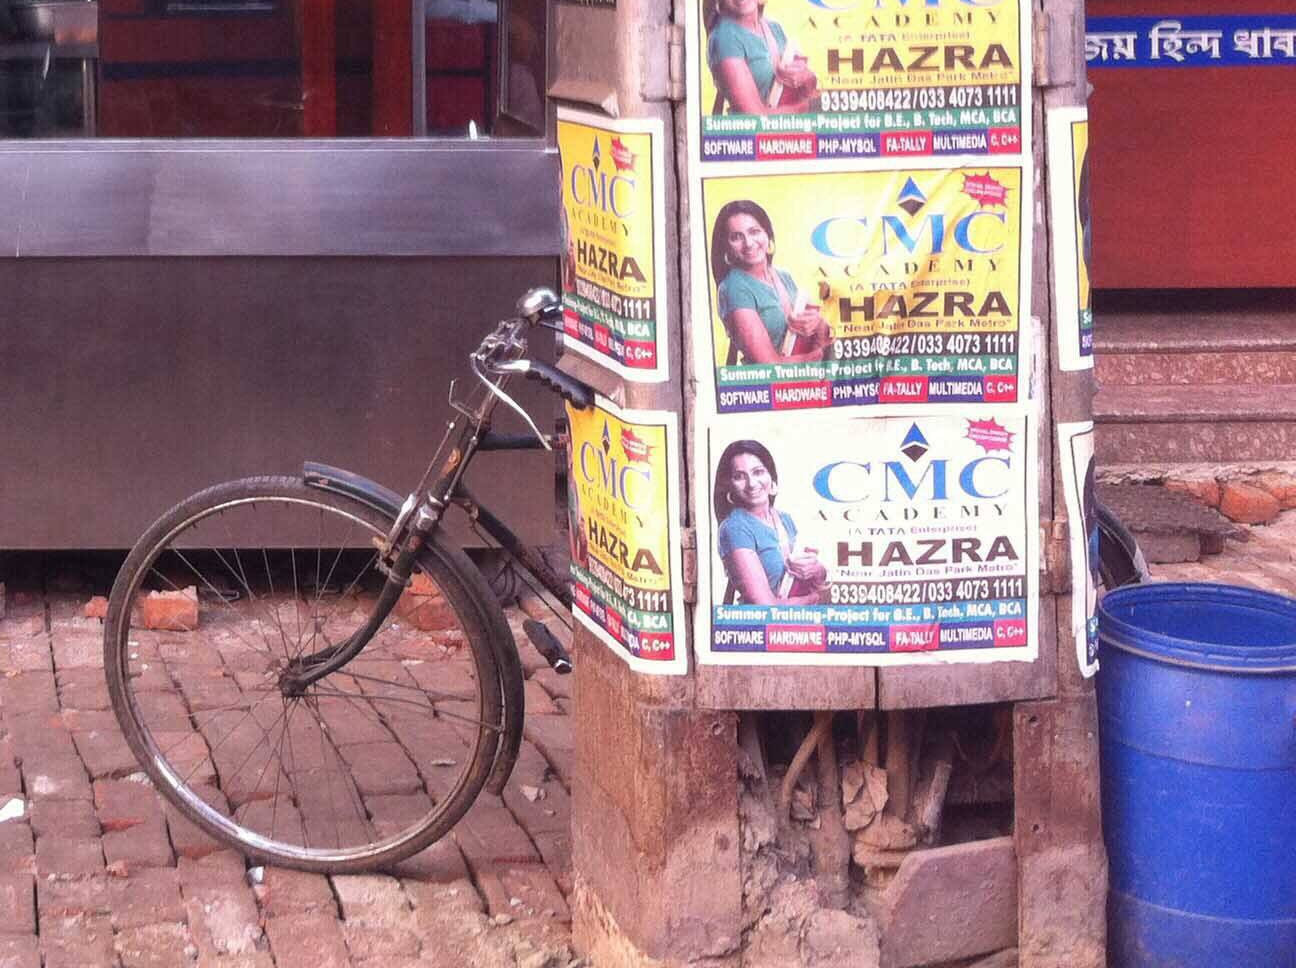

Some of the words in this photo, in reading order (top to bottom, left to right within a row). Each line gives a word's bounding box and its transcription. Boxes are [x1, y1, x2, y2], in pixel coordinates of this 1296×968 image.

[806, 10, 1000, 29] ACADEMY
[1085, 31, 1138, 61] জয়
[1149, 19, 1223, 62] হিন্দ
[827, 43, 1014, 73] HAZRA
[949, 86, 983, 108] 4073
[987, 85, 1018, 106] 1111
[705, 116, 757, 130] Summer
[864, 112, 882, 127] for
[960, 110, 990, 125] MCA,
[704, 139, 754, 155] SOFTWARE
[759, 138, 813, 154] HARDWARE
[819, 137, 877, 153] PHP-MYSQL
[886, 136, 927, 152] FA-TALLY
[933, 135, 988, 151] MULTIMEDIA
[571, 164, 636, 219] CMC
[810, 210, 1006, 258] CMC
[577, 238, 647, 283] HAZRA
[817, 259, 1002, 277] ACADEMY
[623, 298, 651, 319] 1111
[839, 291, 1012, 322] HAZRA
[936, 319, 965, 328] Park
[946, 333, 981, 354] 4073
[985, 334, 1015, 353] 1111
[720, 368, 772, 382] Summer
[957, 358, 987, 372] MCA,
[720, 390, 770, 406] SOFTWARE
[775, 386, 828, 402] HARDWARE
[929, 381, 983, 396] MULTIMEDIA
[580, 441, 651, 509] CMC
[812, 456, 1011, 503] CMC
[816, 504, 1008, 521] ACADEMY
[868, 527, 906, 536] TATA
[588, 516, 664, 575] HAZRA
[837, 536, 1019, 567] HAZRA
[945, 565, 973, 574] Park
[956, 580, 989, 599] 4073
[992, 578, 1023, 597] 1111
[637, 590, 667, 612] 1111
[717, 607, 767, 620] Summer
[872, 608, 891, 621] for
[652, 639, 671, 652] C++
[715, 630, 765, 645] SOFTWARE
[769, 631, 823, 646] HARDWARE
[827, 631, 886, 646] PHP-MYSQL
[940, 627, 993, 642] MULTIMEDIA
